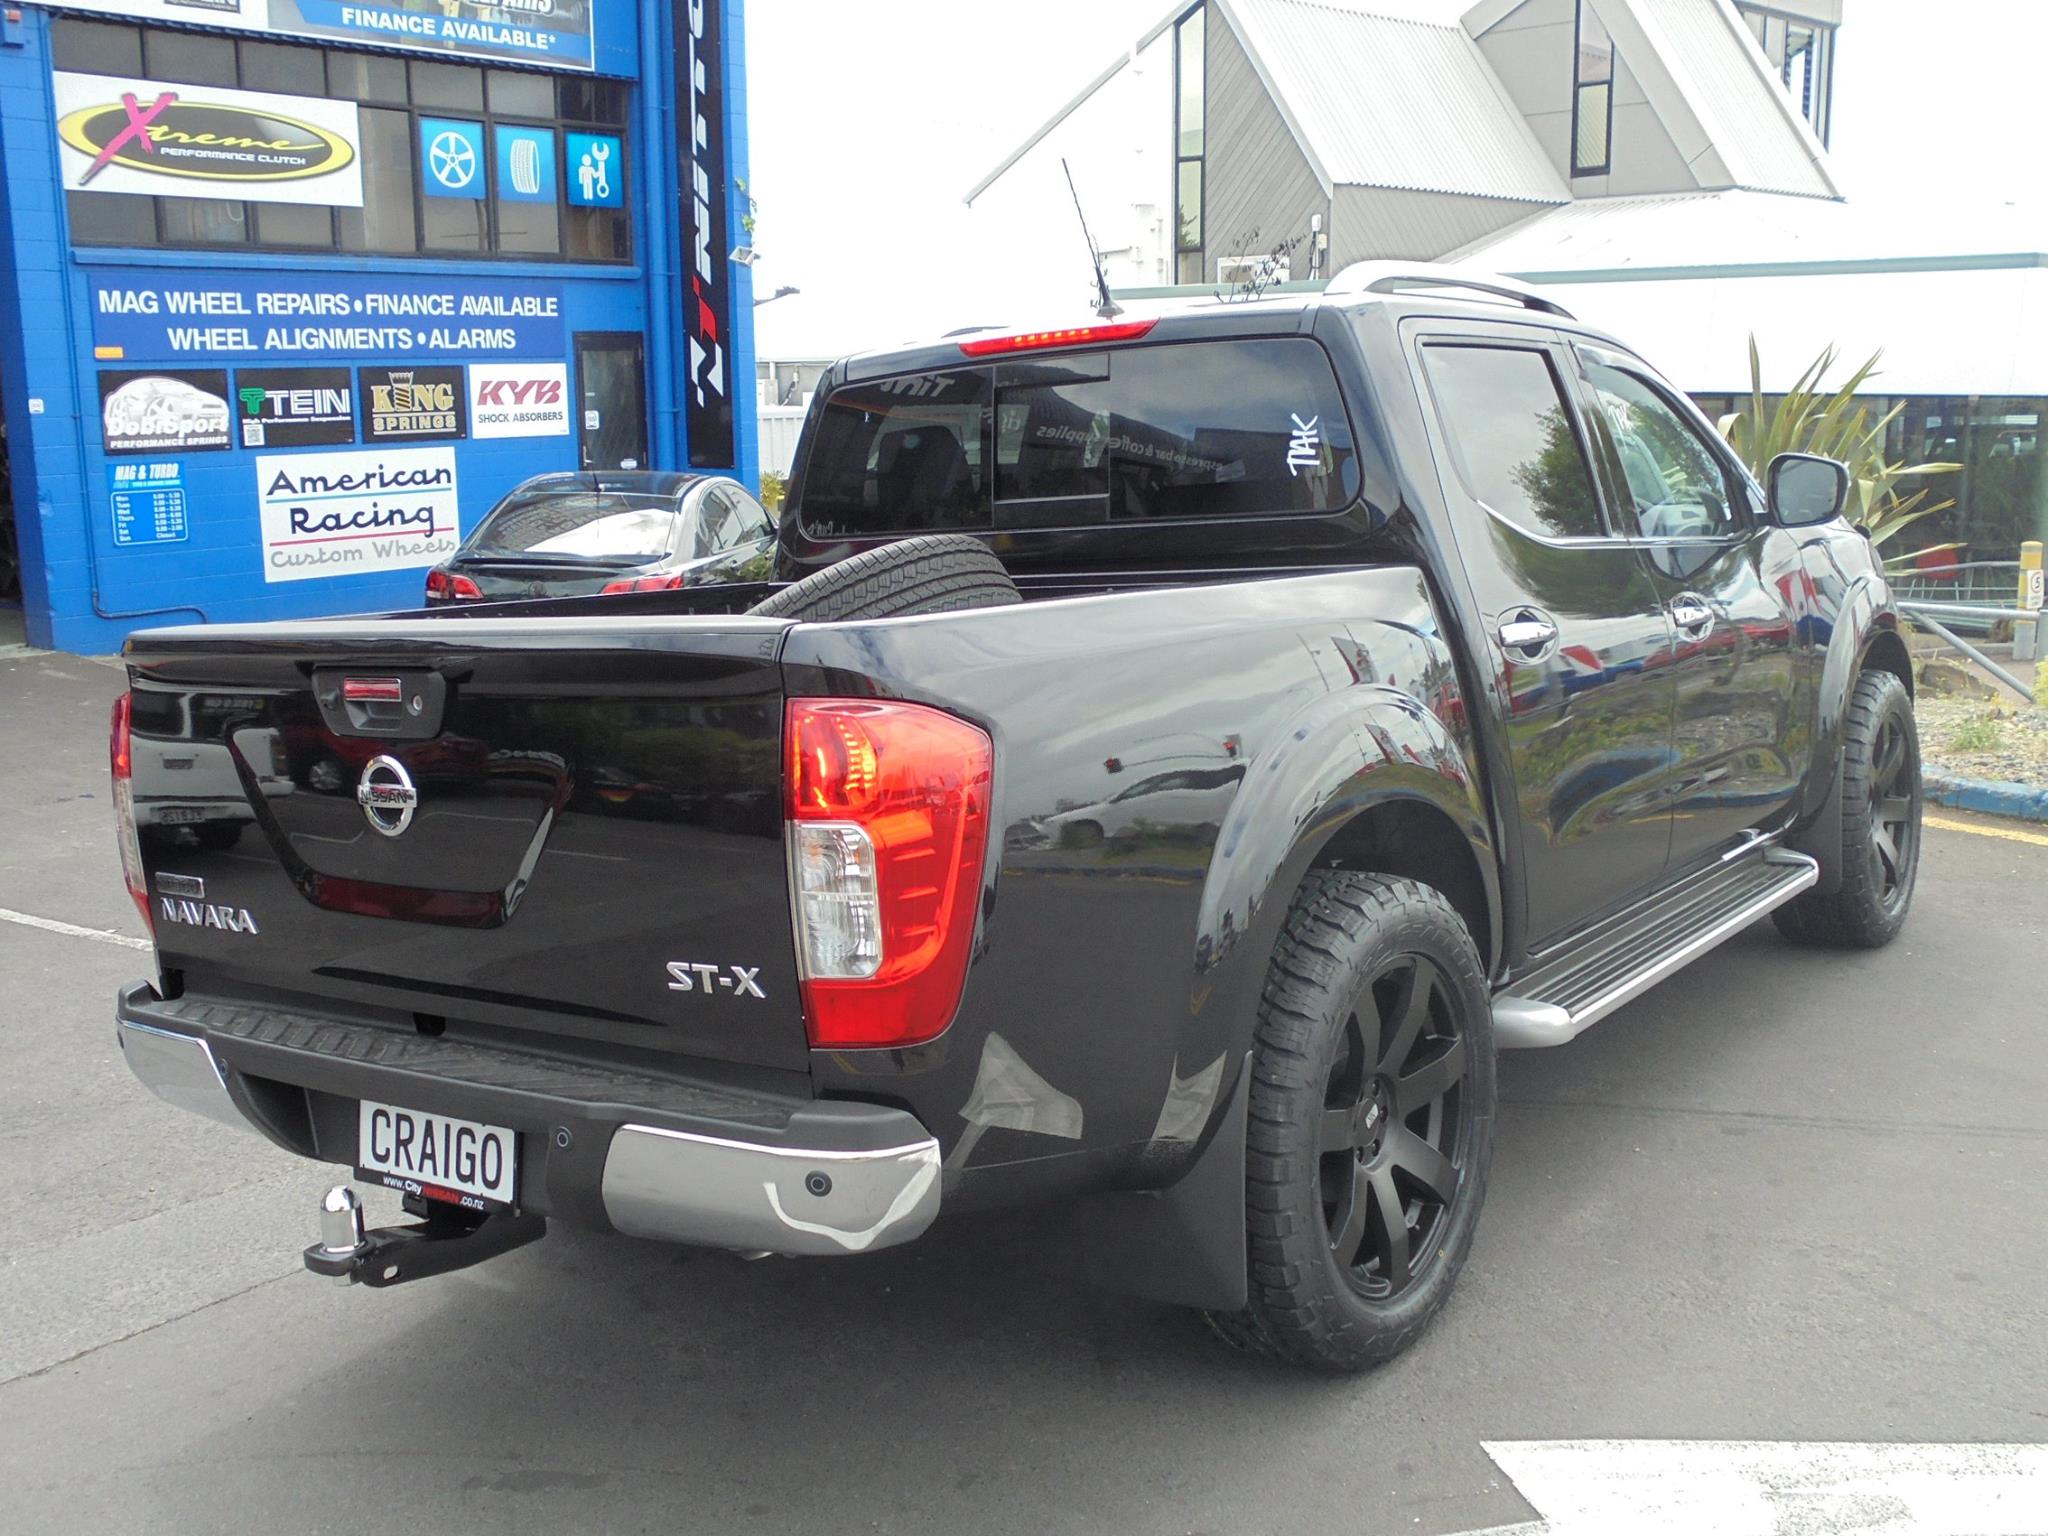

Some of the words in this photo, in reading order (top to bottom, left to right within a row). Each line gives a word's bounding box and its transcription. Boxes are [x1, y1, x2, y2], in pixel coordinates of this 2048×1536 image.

[341, 7, 436, 35] FINANCE
[77, 91, 325, 186] Xtreme
[160, 147, 256, 162] PERFORMANCE
[257, 154, 307, 165] CLUTCH
[98, 290, 159, 314] MAG
[164, 291, 252, 315] WHEEL
[256, 293, 350, 316] REPAIRS
[365, 294, 455, 315] FINANCE
[460, 295, 558, 317] AVAILABLE
[167, 328, 258, 350] WHEEL
[264, 328, 413, 350] ALIGNMENTS
[429, 328, 516, 349] ALARMS
[264, 389, 350, 416] TEIN
[371, 371, 455, 413] KING
[477, 380, 562, 405] KYB
[373, 413, 456, 431] SPRINGS
[478, 413, 510, 424] SHOCK
[513, 411, 563, 422] ABSORBERS
[110, 438, 185, 449] PERFORMANCE
[187, 436, 228, 446] SPRINGS
[115, 465, 137, 480] MAG
[138, 464, 147, 479] &
[149, 463, 179, 479] TURBO
[266, 464, 452, 496] American
[290, 502, 434, 538] Racing
[271, 546, 363, 568] Custom
[372, 538, 456, 560] Wheels
[360, 788, 409, 804] NISSAN
[160, 896, 259, 935] NAVARA
[666, 961, 767, 999] ST-X
[371, 1108, 503, 1191] CRAIGO
